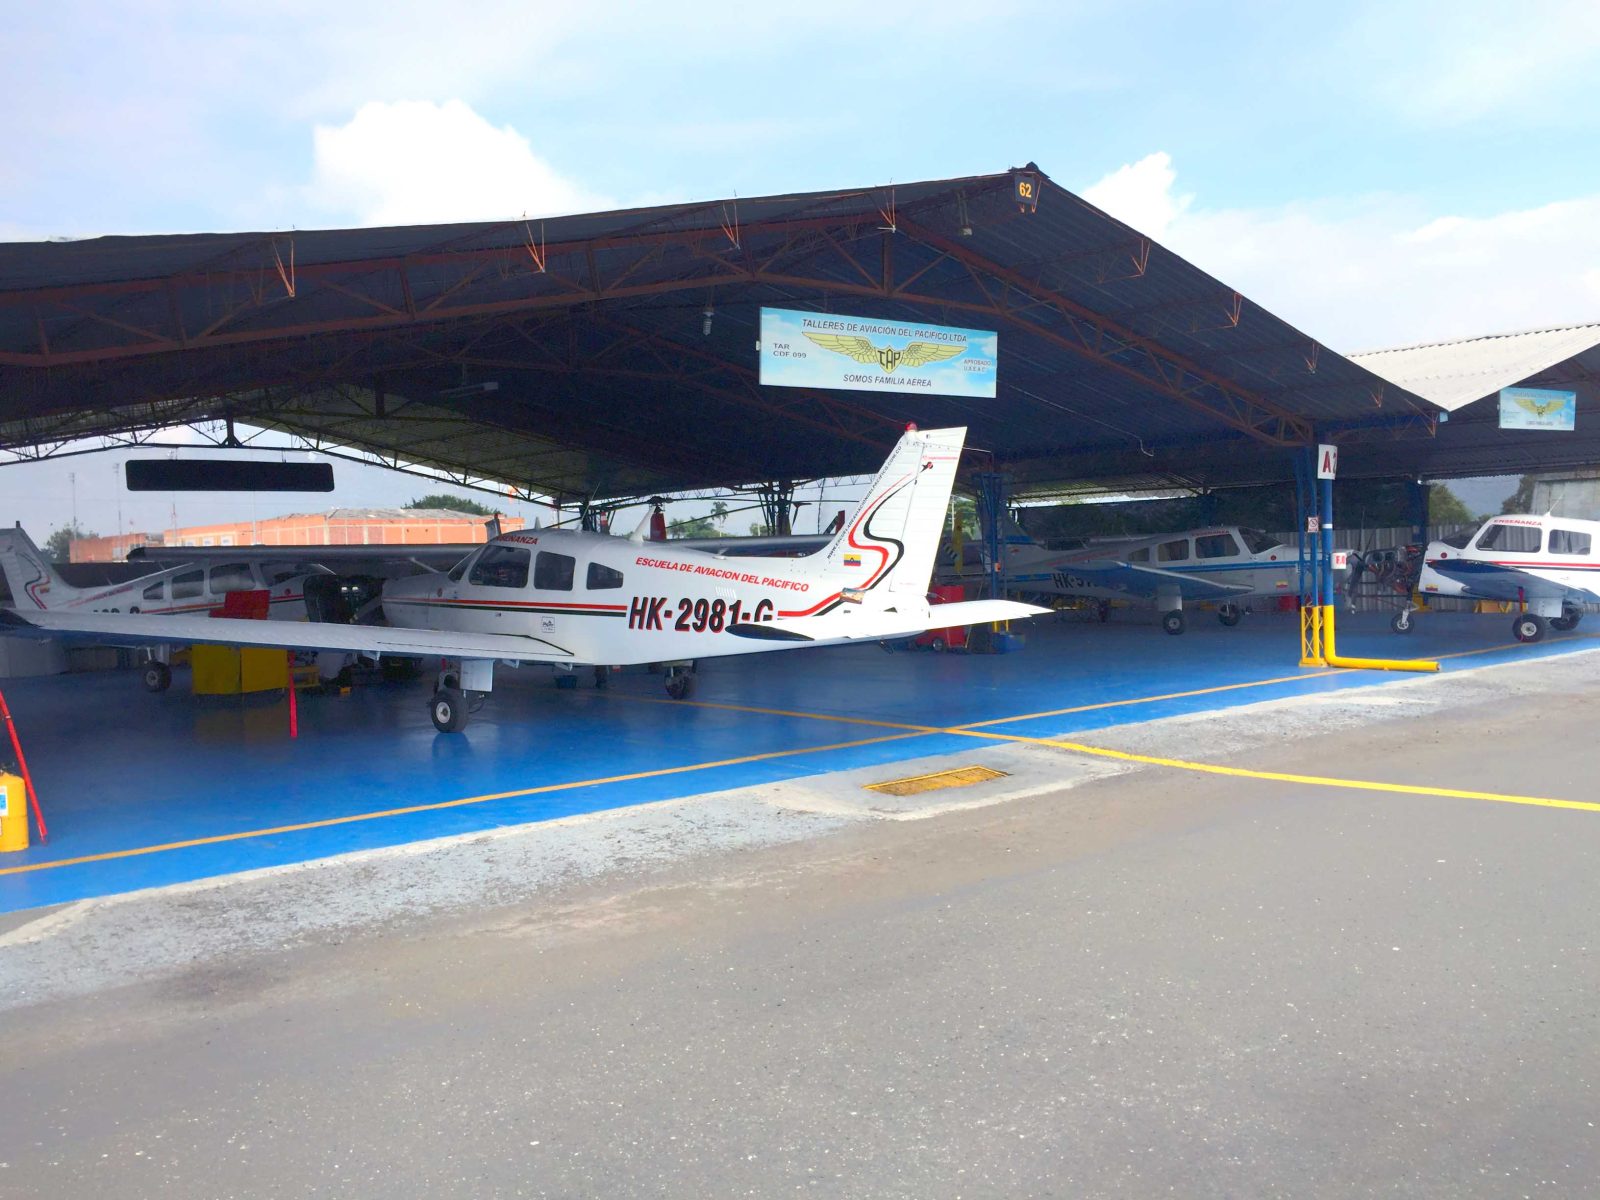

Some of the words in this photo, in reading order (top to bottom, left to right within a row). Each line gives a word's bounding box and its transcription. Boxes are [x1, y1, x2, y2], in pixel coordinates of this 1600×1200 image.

[1019, 182, 1032, 198] 62
[802, 318, 845, 331] TALLERES
[847, 322, 858, 332] DE
[898, 328, 912, 337] DEL
[950, 333, 967, 342] LTDA
[773, 342, 790, 350] TAR
[843, 374, 873, 384] SOMOS
[874, 376, 905, 385] FAMILIA
[635, 557, 678, 571] ESCUELA
[679, 563, 693, 573] DE
[694, 566, 740, 582] AVIACION
[740, 574, 760, 585] DEL
[762, 577, 809, 592] PACIFICO
[628, 597, 774, 633] HK-2981-G
